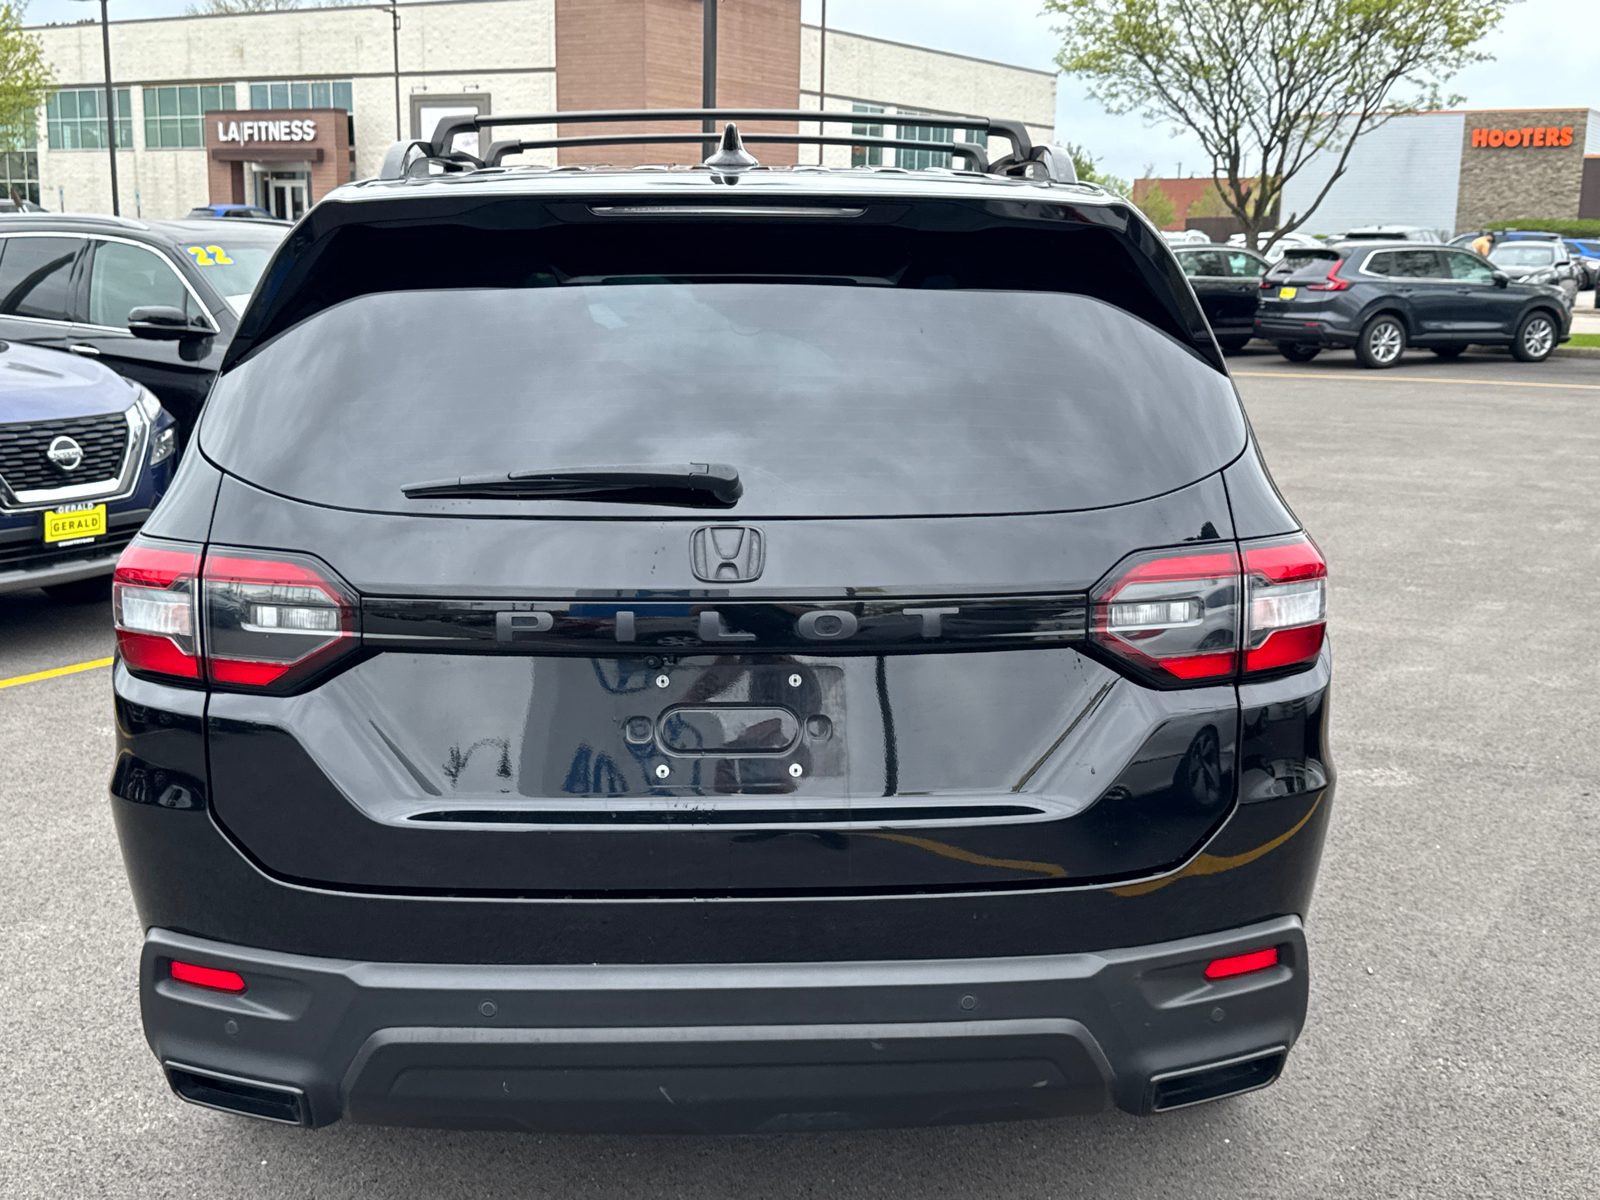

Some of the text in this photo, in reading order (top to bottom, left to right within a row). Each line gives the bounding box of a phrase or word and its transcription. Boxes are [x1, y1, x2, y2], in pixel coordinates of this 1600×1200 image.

[243, 119, 316, 142] FITNESS
[1471, 126, 1574, 148] HOOTERS
[187, 245, 234, 266] 22
[57, 502, 94, 514] GERALD
[53, 517, 98, 533] GERALD
[495, 606, 960, 643] PILOT
